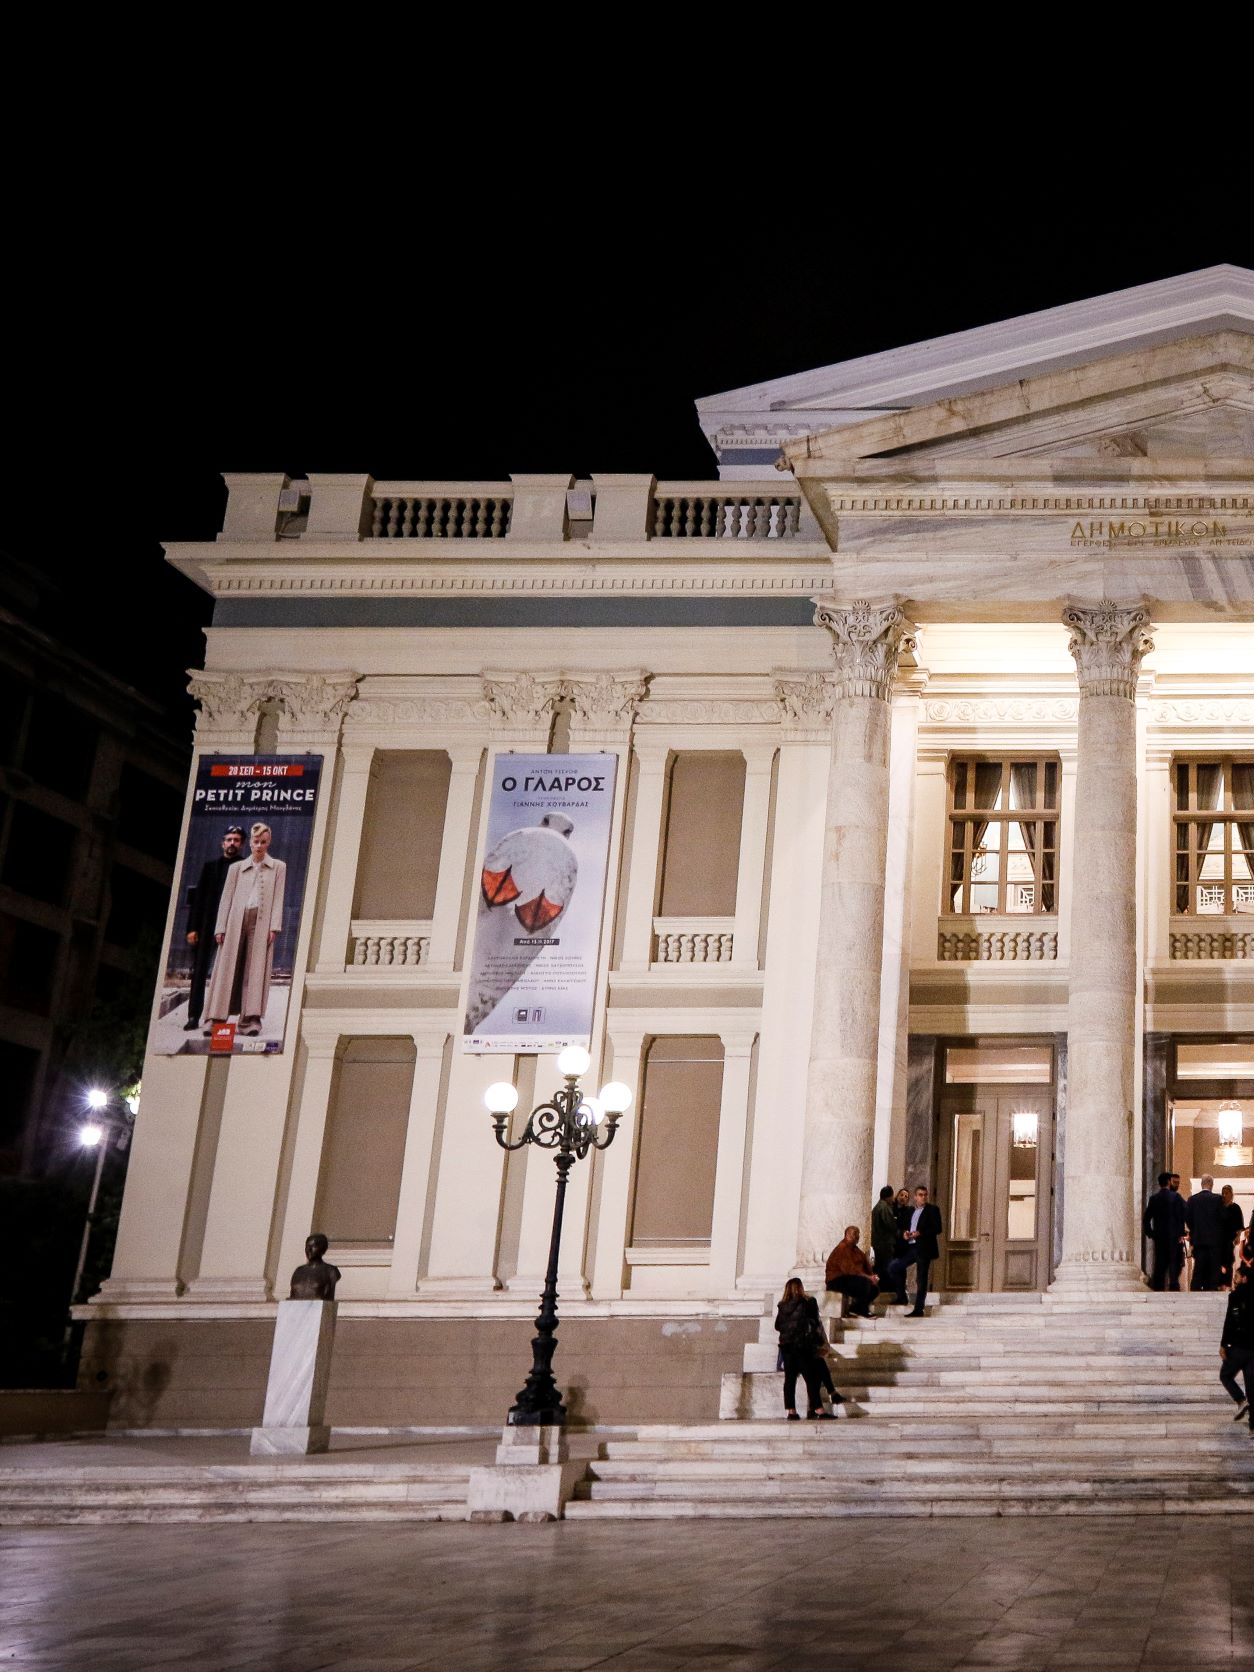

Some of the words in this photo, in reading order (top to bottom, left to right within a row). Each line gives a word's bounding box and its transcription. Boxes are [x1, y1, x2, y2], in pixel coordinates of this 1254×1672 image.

[1070, 519, 1228, 539] ΔΗΜΟΤΙΚΟΝ
[239, 765, 255, 776] ΣΕΠ
[262, 765, 272, 775] 15
[272, 765, 288, 775] ΟΚΤ
[235, 780, 277, 788] mon
[501, 777, 518, 792] Ο
[523, 777, 605, 792] ΓΛΑΡΟΣ
[195, 789, 245, 801] PETIT
[250, 789, 315, 801] PRINCE
